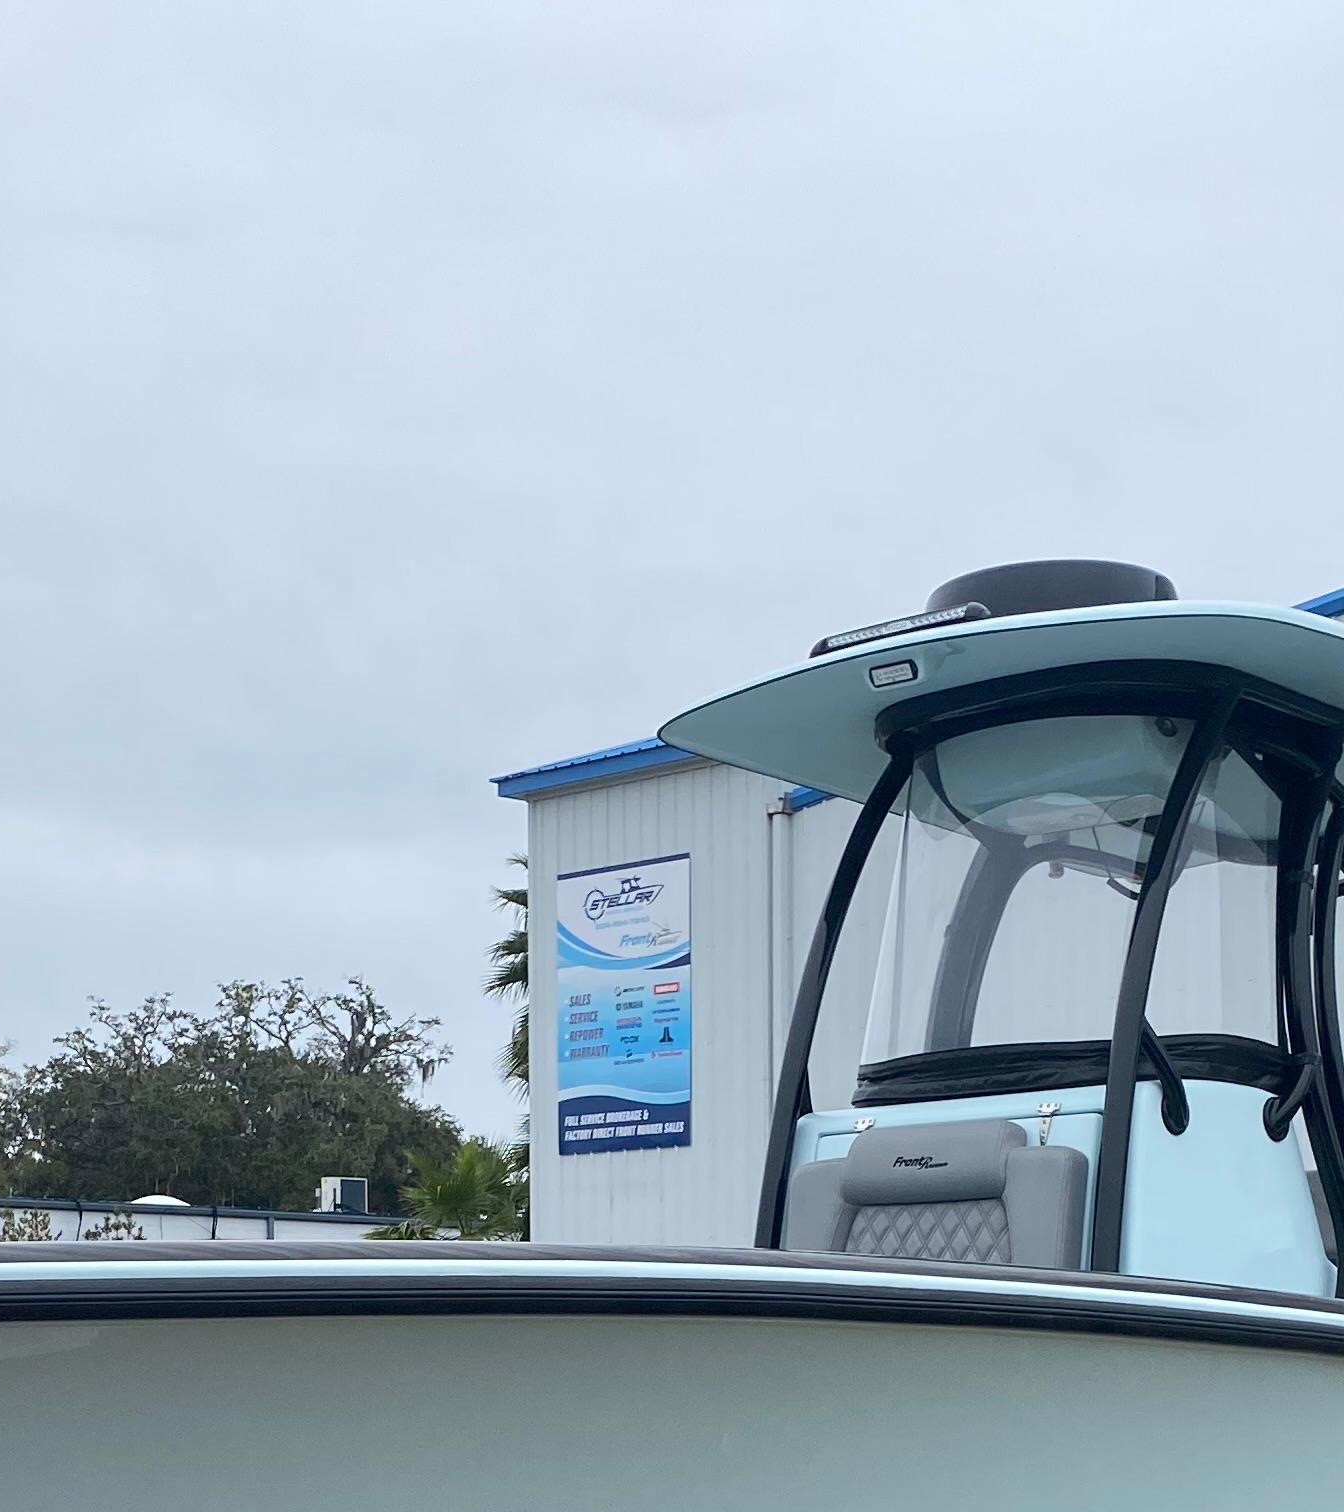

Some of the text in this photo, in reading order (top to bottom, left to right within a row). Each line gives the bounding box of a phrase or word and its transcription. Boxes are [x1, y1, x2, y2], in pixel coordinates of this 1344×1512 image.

[589, 890, 654, 911] STELLAR
[569, 993, 591, 1007] SALES
[569, 1011, 598, 1024] SERVICE
[569, 1028, 604, 1041] REPOWER
[564, 1115, 579, 1127] FULL
[580, 1113, 605, 1126] SERVICE
[564, 1129, 592, 1141] FACTORY
[592, 1127, 615, 1139] DIRECT
[615, 1125, 636, 1137] FRONT
[664, 1121, 684, 1133] SALES
